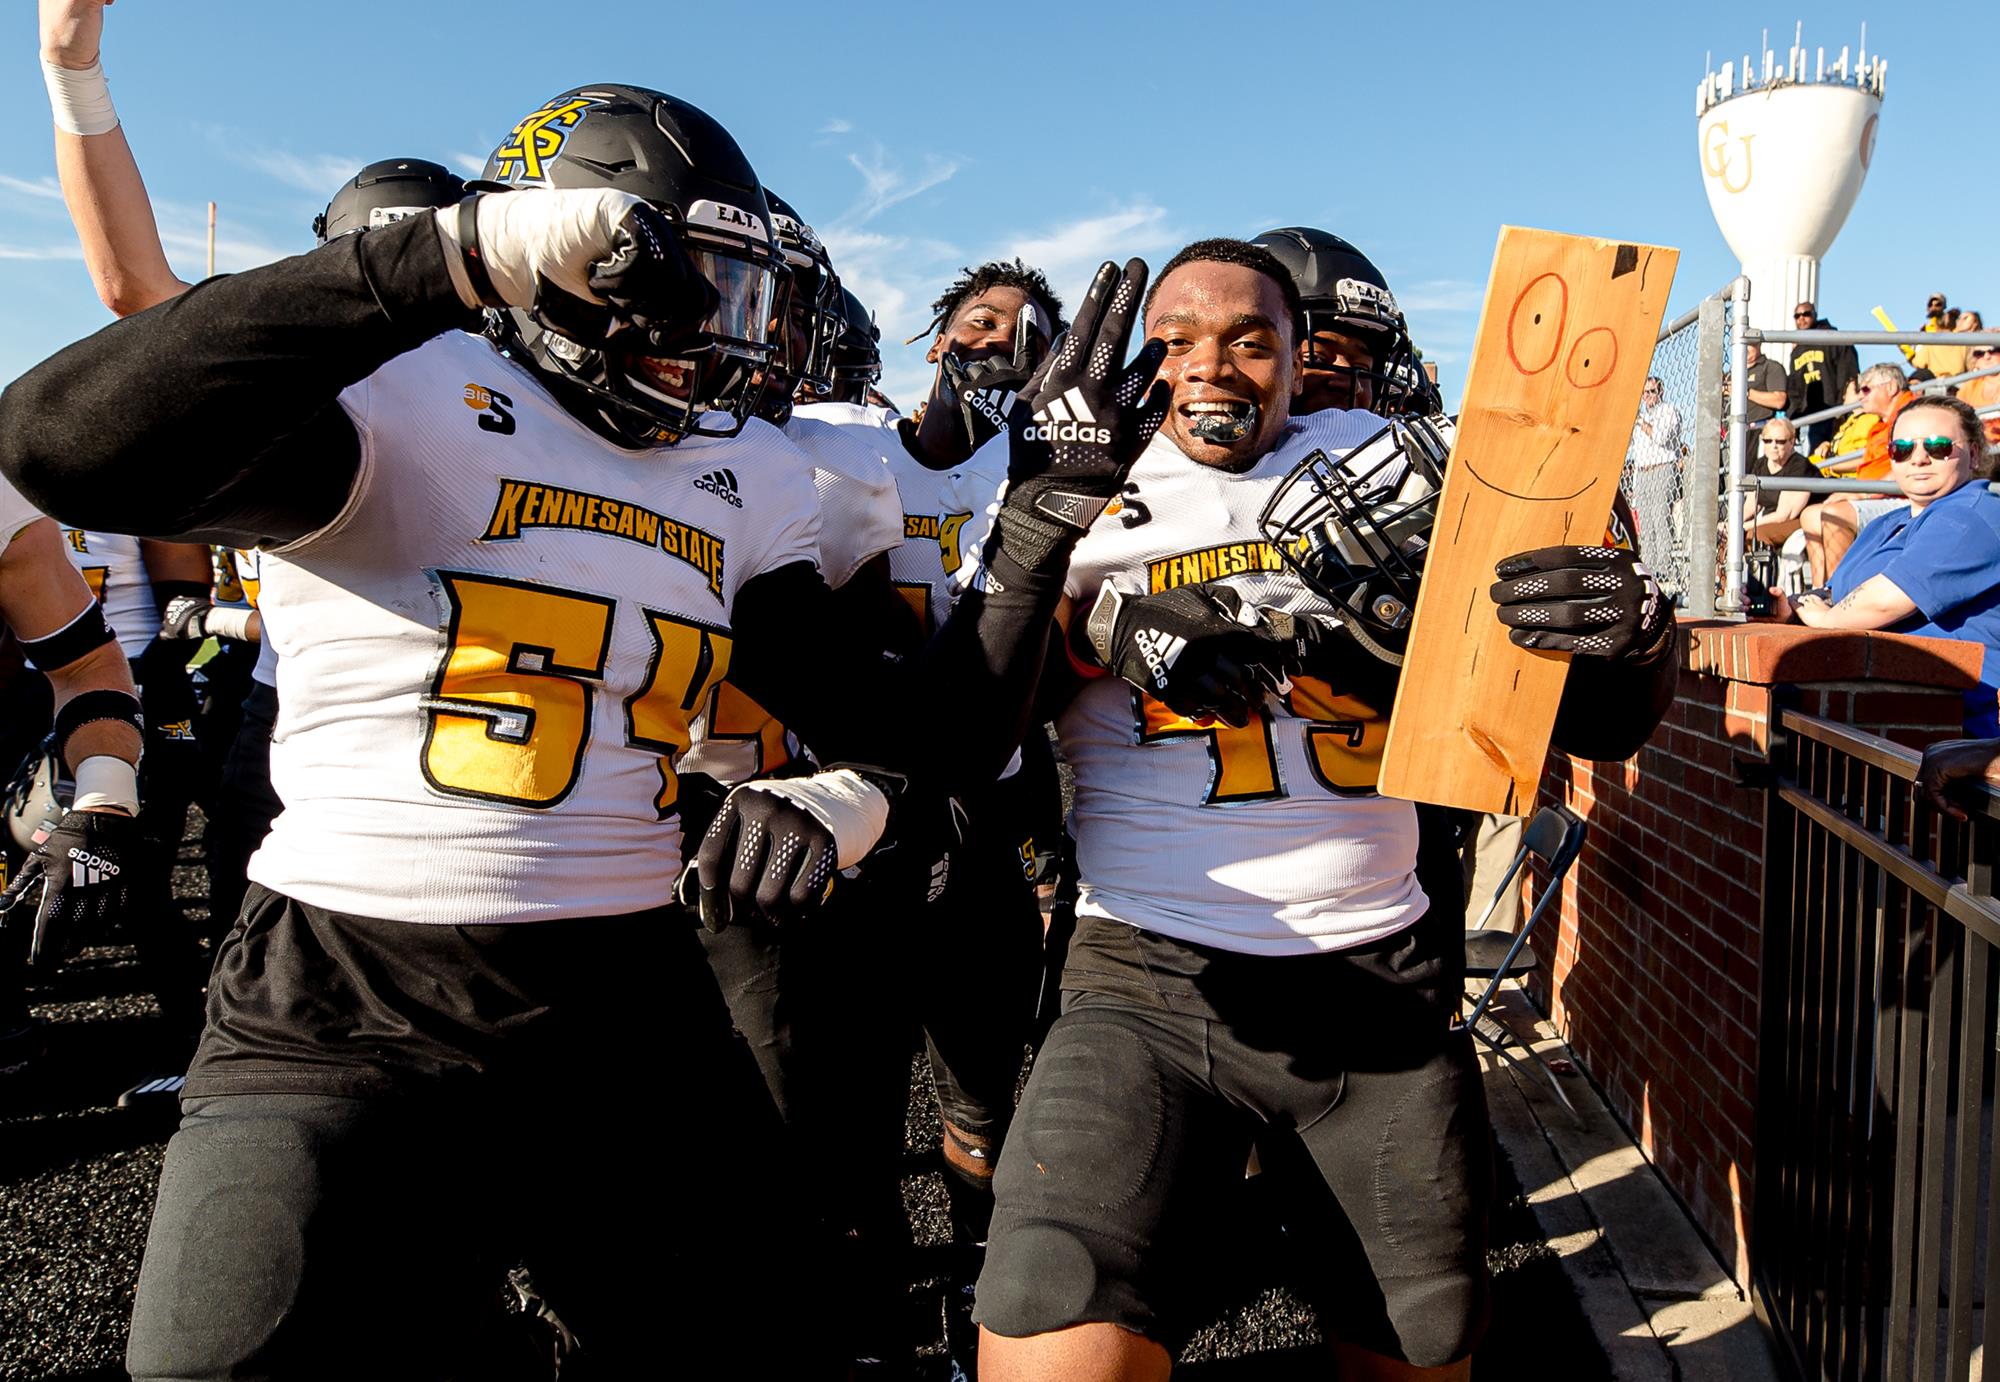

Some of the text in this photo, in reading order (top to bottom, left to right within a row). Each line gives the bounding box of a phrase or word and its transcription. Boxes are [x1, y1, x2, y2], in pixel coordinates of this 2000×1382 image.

[964, 389, 1009, 433] adidas
[1023, 419, 1111, 445] adidas
[693, 479, 743, 509] adidas
[489, 482, 723, 595] KENNESAW STATE
[1151, 542, 1283, 596] KENNESAW
[1095, 599, 1113, 650] ADIZERO
[1134, 629, 1169, 689] adidas
[67, 847, 121, 876] adidas
